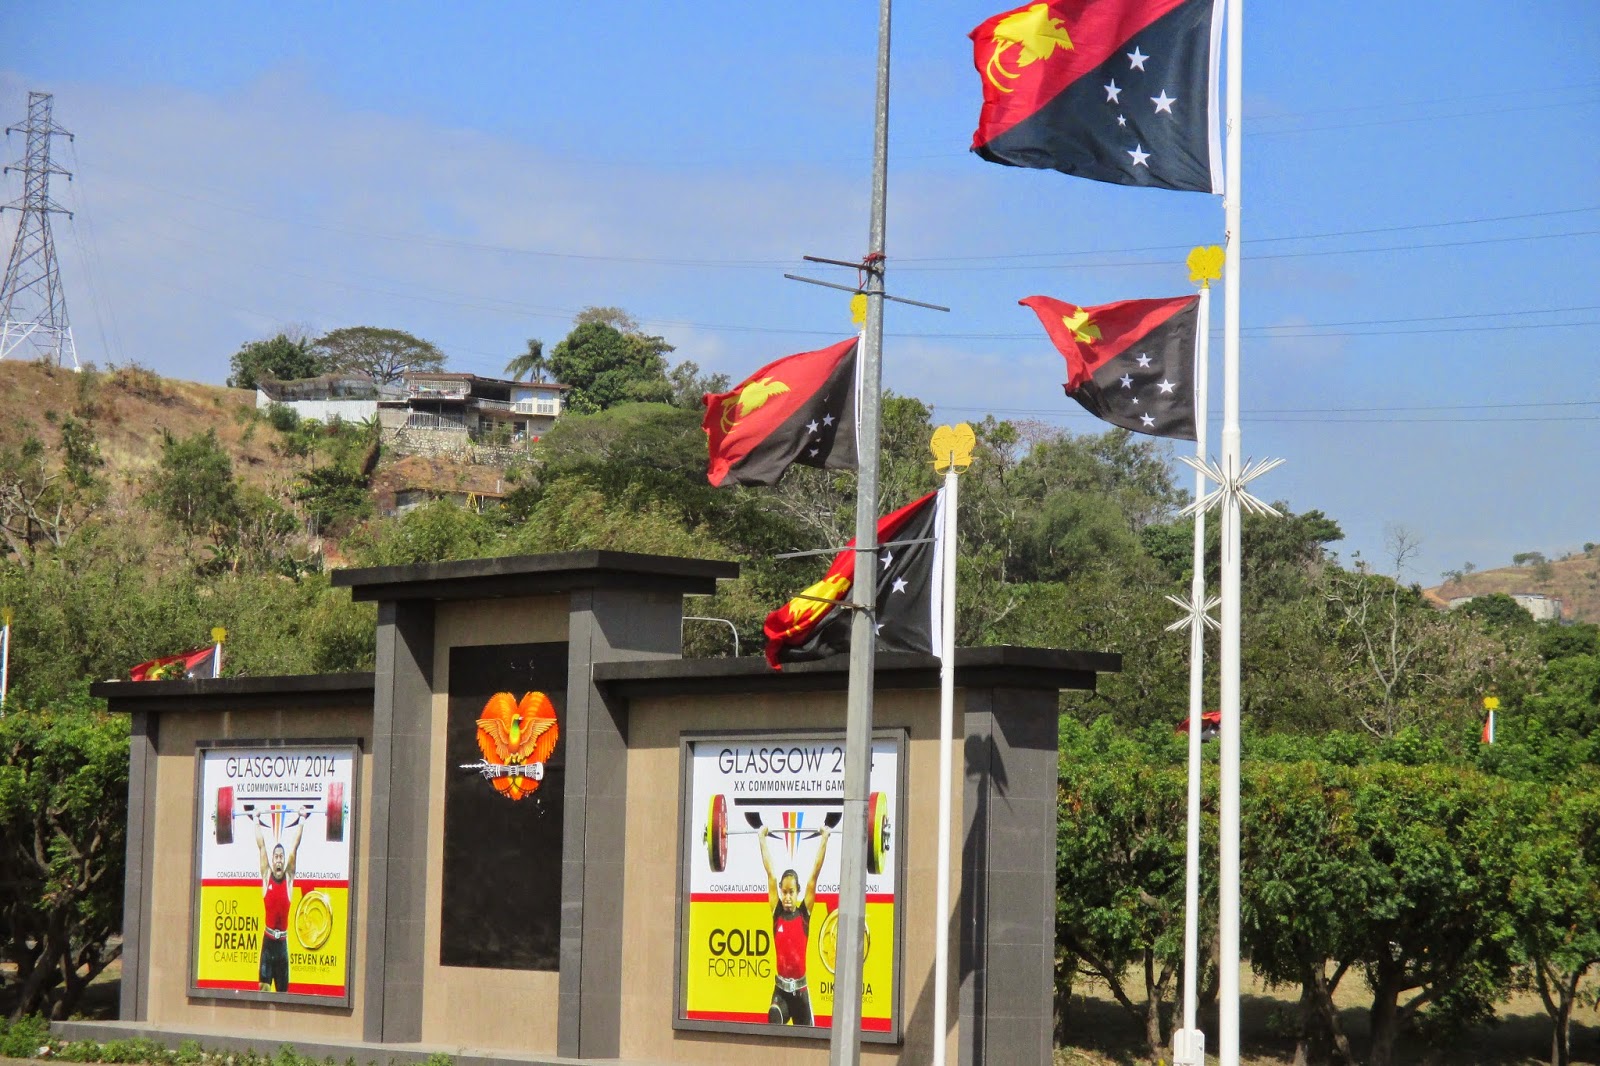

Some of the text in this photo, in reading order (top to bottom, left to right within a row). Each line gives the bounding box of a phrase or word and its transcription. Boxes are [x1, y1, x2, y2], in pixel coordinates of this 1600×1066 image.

[226, 755, 335, 778] GLASGOW 2014
[719, 747, 824, 774] GLASGOW
[237, 783, 323, 792] XX COMMONWEALTH GAMES
[734, 779, 845, 792] XX COMMONWEALTH GAM
[710, 884, 768, 892] CONGRATULATIONS!
[215, 900, 238, 915] OUR
[215, 916, 259, 931] GOLDEN
[214, 932, 258, 950] DREAM
[708, 928, 770, 957] GOLD
[213, 951, 258, 964] CAME TRUE
[290, 953, 337, 967] STEVEN KARI
[708, 957, 771, 978] FOR PNG
